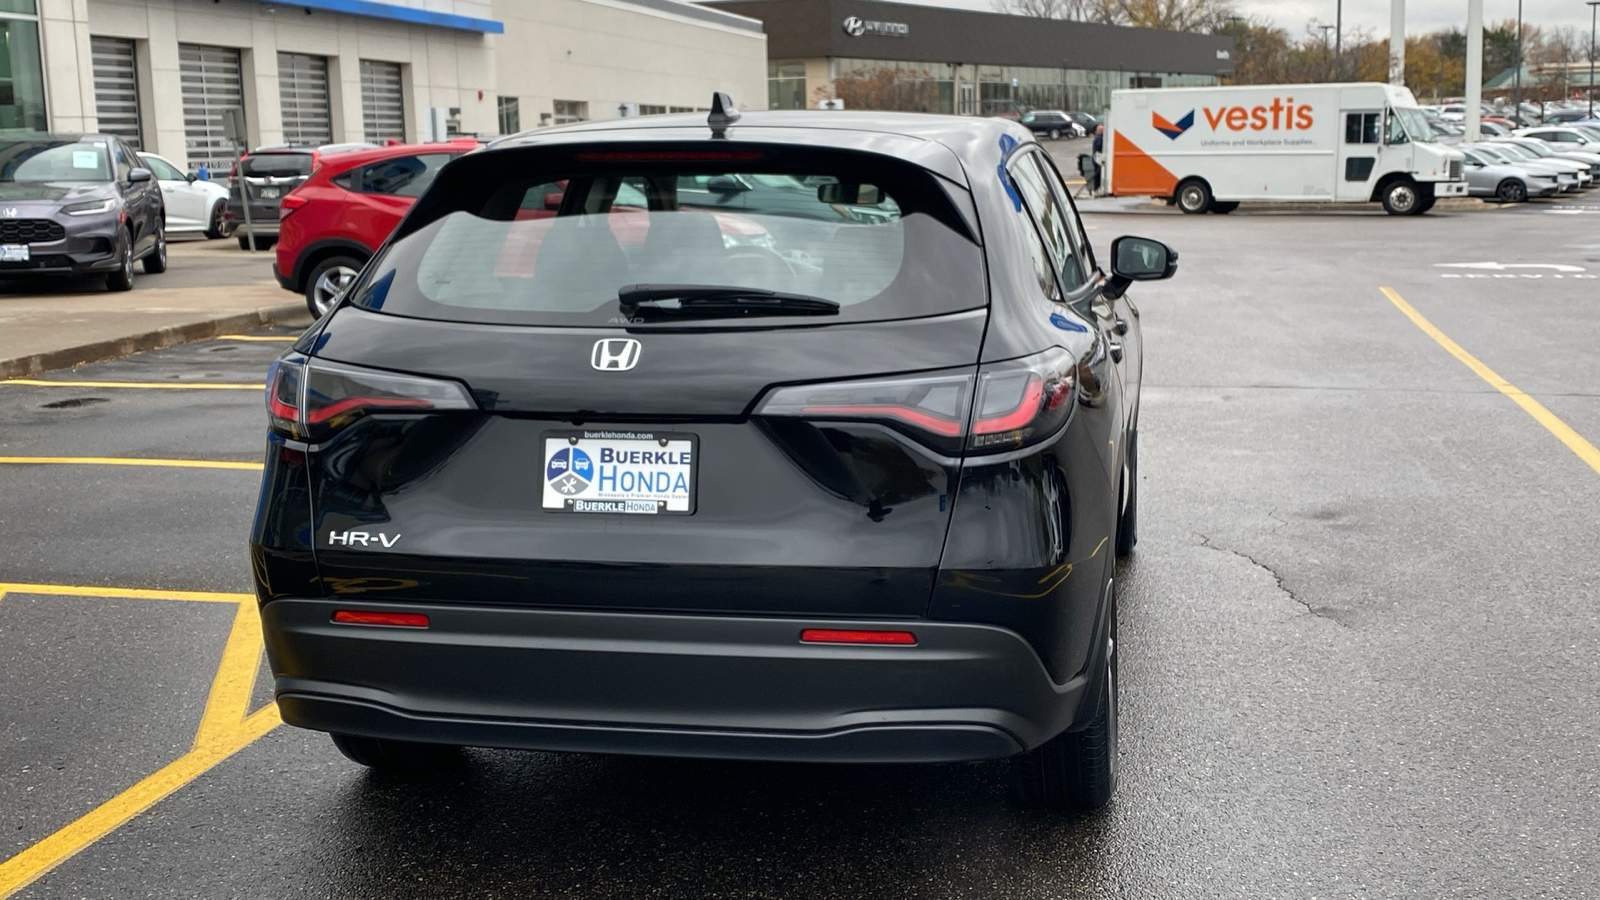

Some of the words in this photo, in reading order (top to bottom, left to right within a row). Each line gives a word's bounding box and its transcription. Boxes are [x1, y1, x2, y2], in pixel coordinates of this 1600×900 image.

[1202, 97, 1314, 132] vestis
[1232, 139, 1245, 147] and
[1246, 138, 1282, 147] Workplace
[584, 431, 654, 440] buerklehonda.com
[600, 447, 691, 465] BUERKLE
[598, 465, 689, 493] HONDA
[575, 500, 625, 511] BUERKLE
[626, 501, 656, 511] HONDA
[328, 530, 402, 548] HR-V
